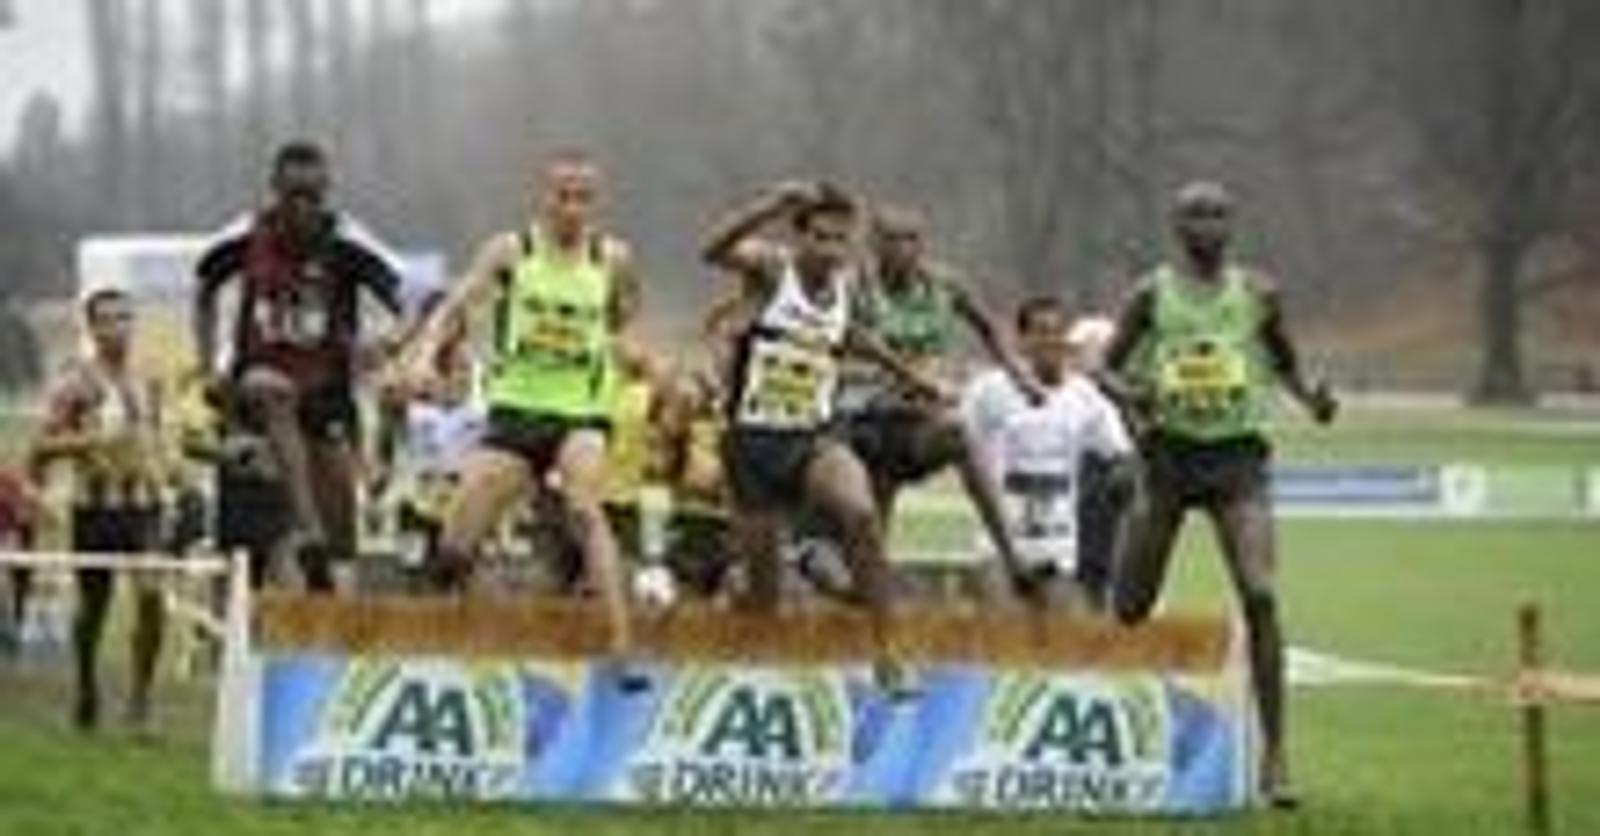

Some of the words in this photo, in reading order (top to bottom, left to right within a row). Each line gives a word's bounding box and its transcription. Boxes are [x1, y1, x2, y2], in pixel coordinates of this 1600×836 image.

[373, 681, 474, 756] AA
[702, 686, 801, 757] AA
[1023, 695, 1125, 765] AA
[340, 756, 480, 797] DRINK
[672, 759, 811, 801] DRINK
[995, 765, 1136, 803] DRINK
